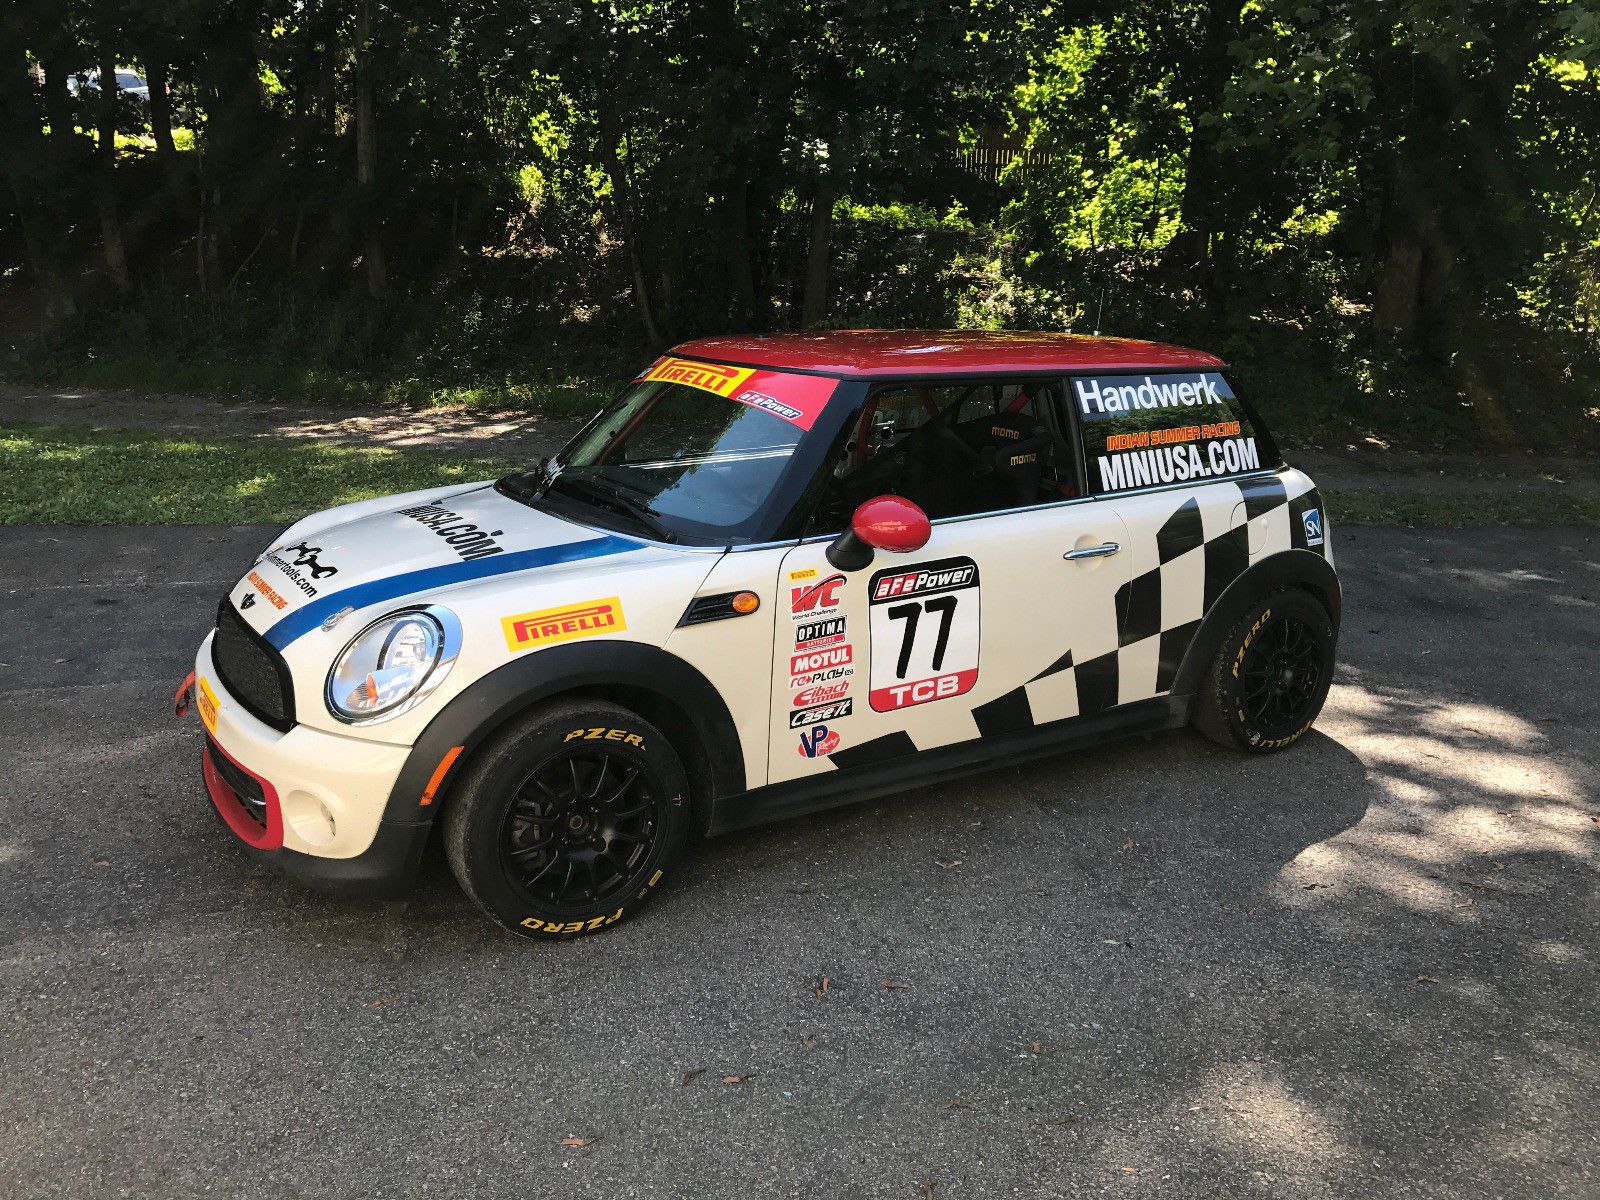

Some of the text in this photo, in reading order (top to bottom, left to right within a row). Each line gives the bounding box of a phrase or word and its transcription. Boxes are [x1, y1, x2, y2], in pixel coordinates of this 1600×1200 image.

[654, 359, 740, 392] PIRELLI
[1075, 373, 1223, 414] Handwerk
[1106, 420, 1241, 452] INDIAN SUMMER RACING
[1097, 437, 1261, 492] MINIUSA.COM
[394, 504, 505, 562] USA.COM
[512, 604, 615, 643] PIRELLI
[798, 620, 844, 641] OPTIMA
[888, 595, 959, 680] 77
[806, 636, 835, 647] BATTERIES
[793, 647, 850, 673] MOTUL
[793, 679, 850, 707] Eibach
[889, 675, 959, 706] TCB
[791, 706, 835, 727] Case
[563, 727, 647, 752] PZER
[800, 724, 829, 758] VP
[519, 907, 624, 934] PZERO
